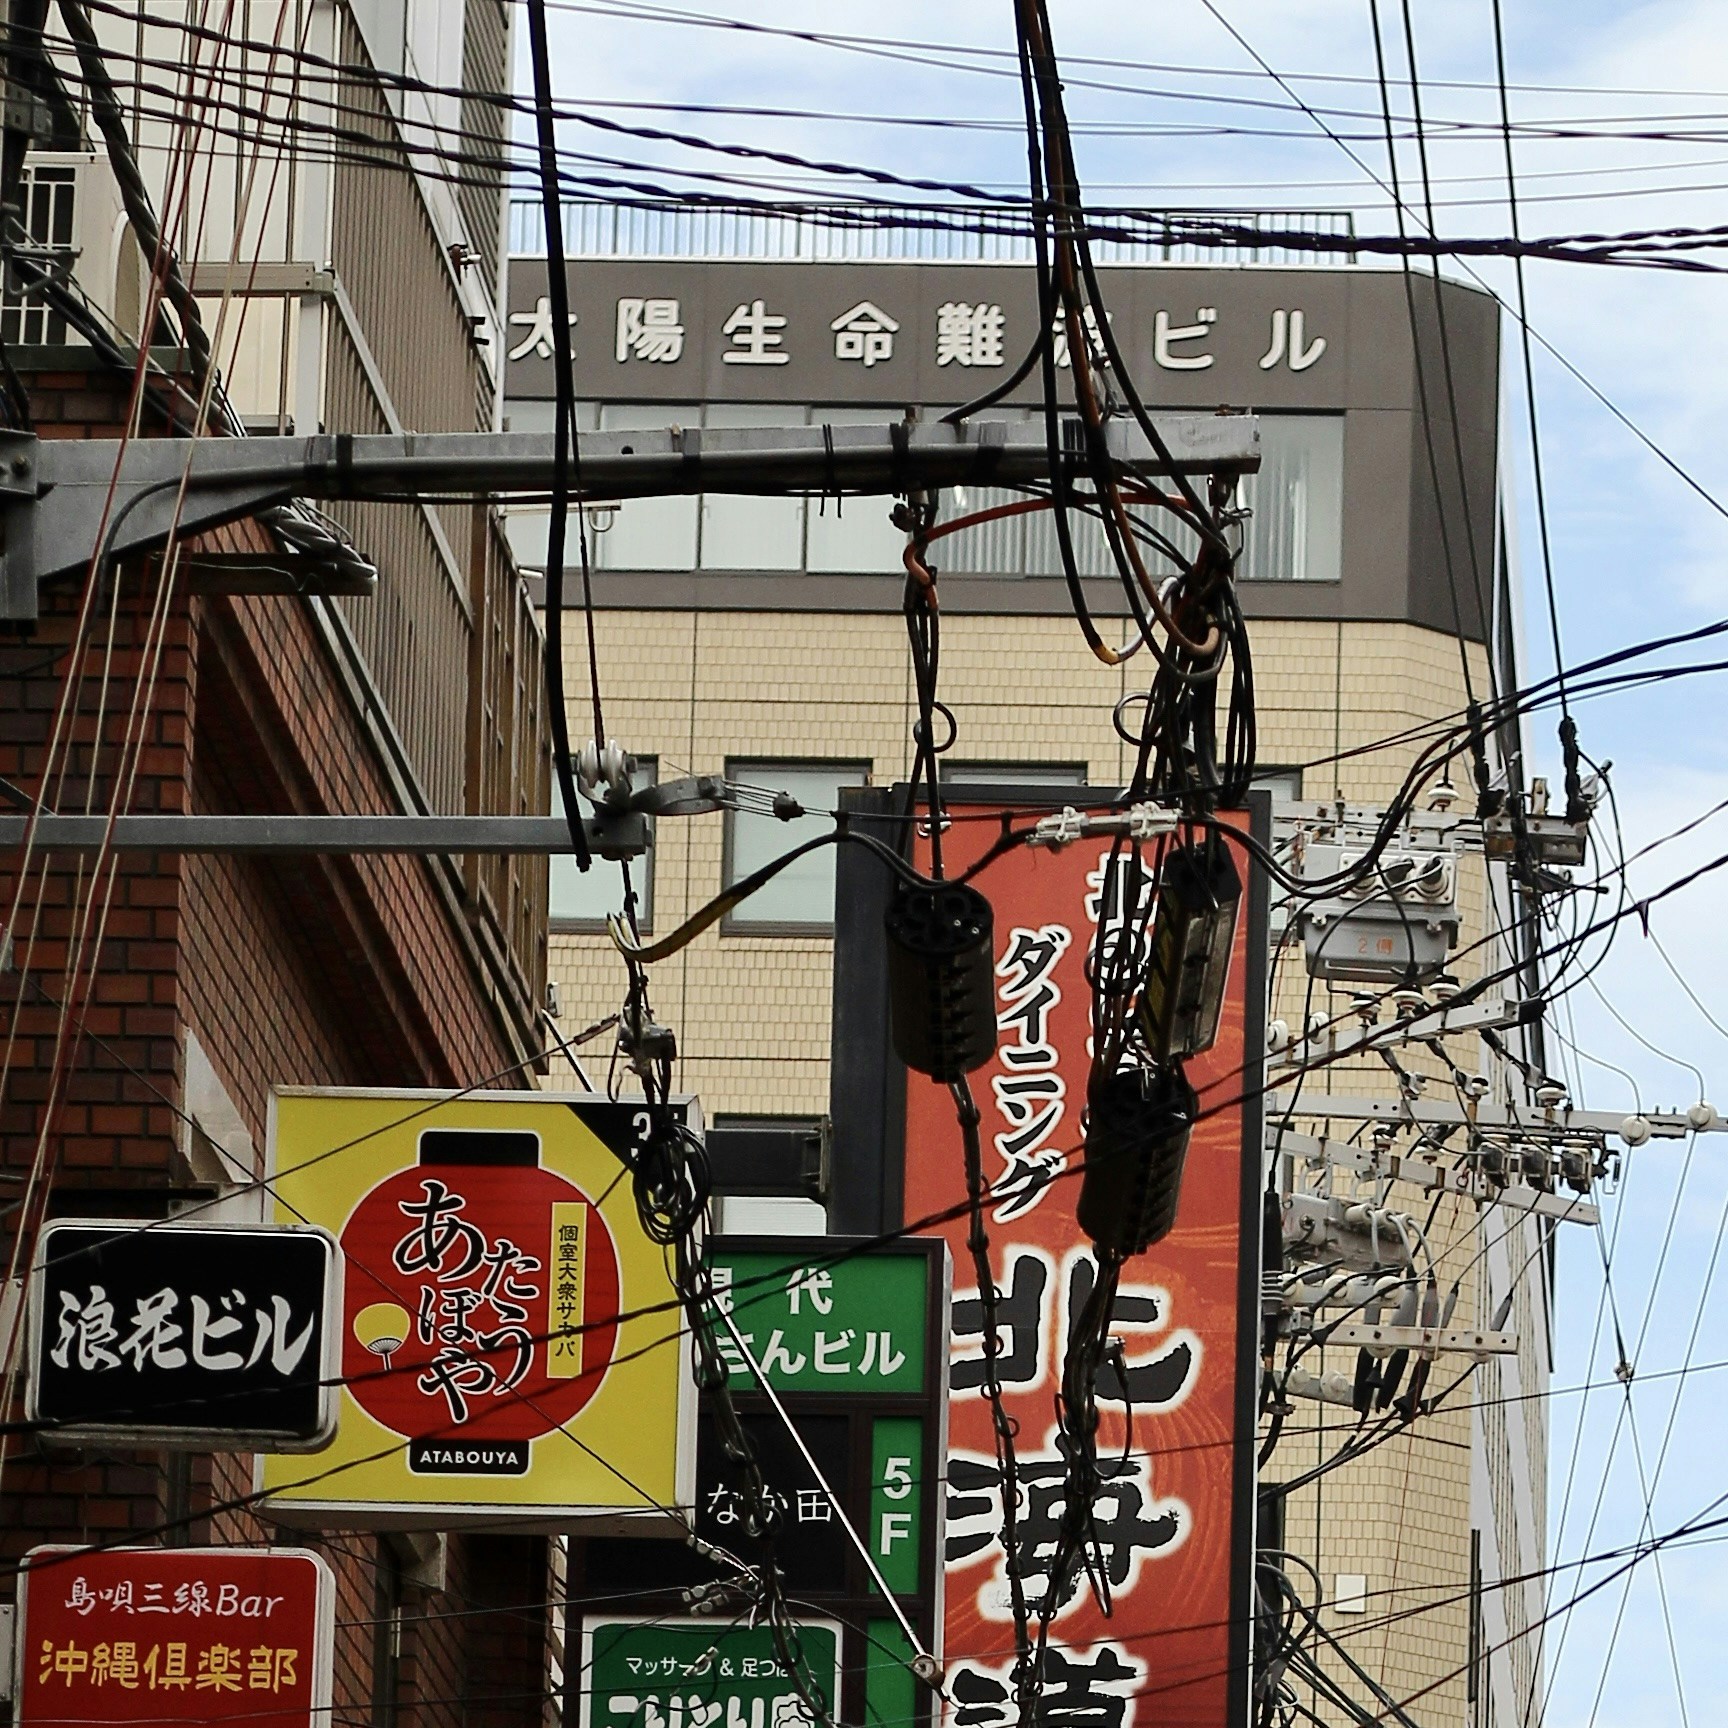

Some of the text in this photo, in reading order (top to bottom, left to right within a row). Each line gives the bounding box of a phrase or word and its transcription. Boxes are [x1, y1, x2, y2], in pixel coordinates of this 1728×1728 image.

[994, 925, 1070, 1224] ダイニング
[49, 1284, 318, 1377] 浪花ビル
[419, 1449, 520, 1467] ATABOUYA
[706, 1480, 832, 1527] なか田
